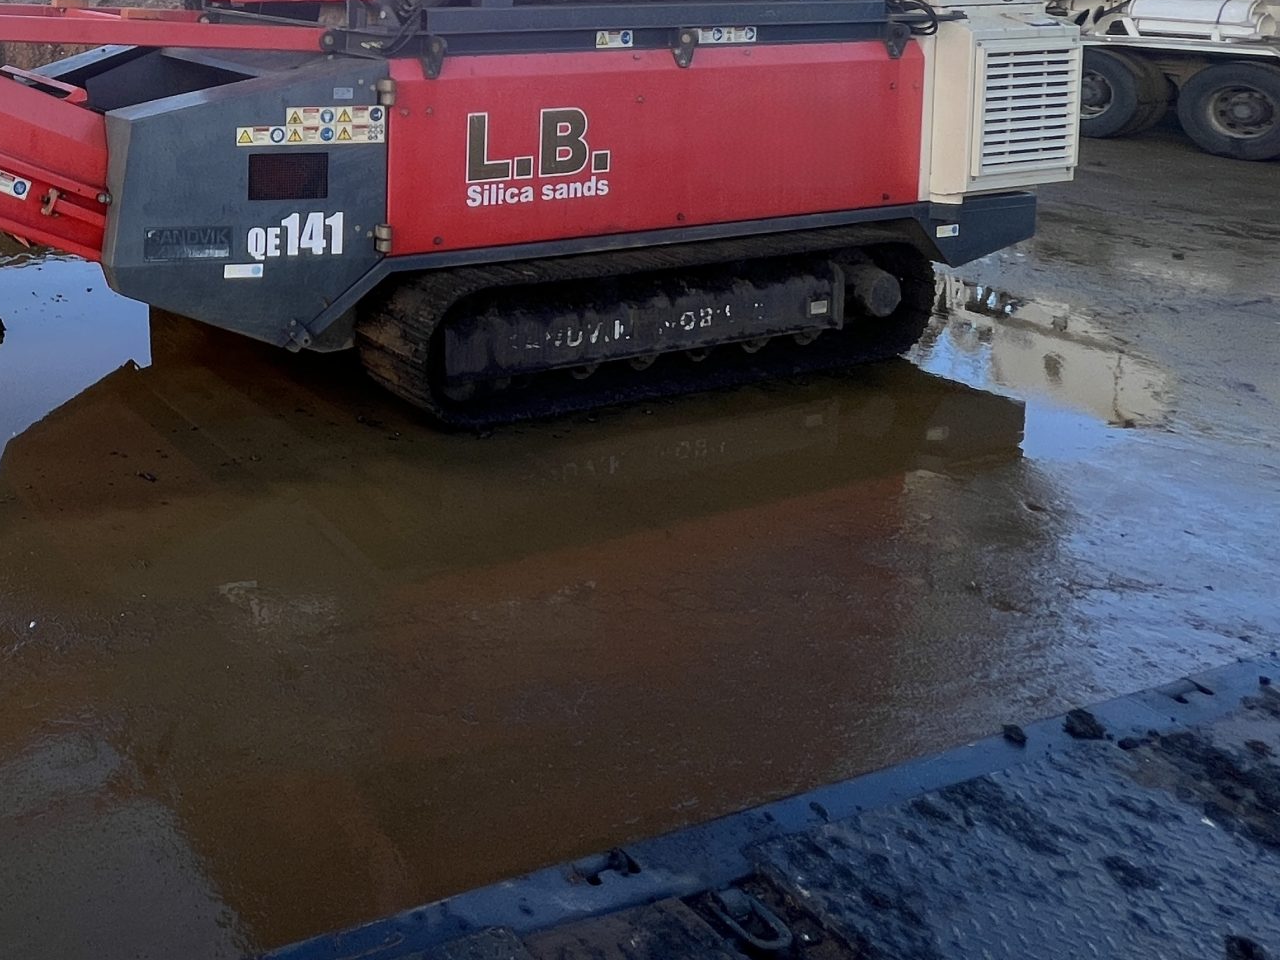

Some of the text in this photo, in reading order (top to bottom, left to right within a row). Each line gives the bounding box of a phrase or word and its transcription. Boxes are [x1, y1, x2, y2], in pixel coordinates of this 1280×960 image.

[465, 107, 611, 183] L.B.
[466, 176, 609, 207] Silica sands
